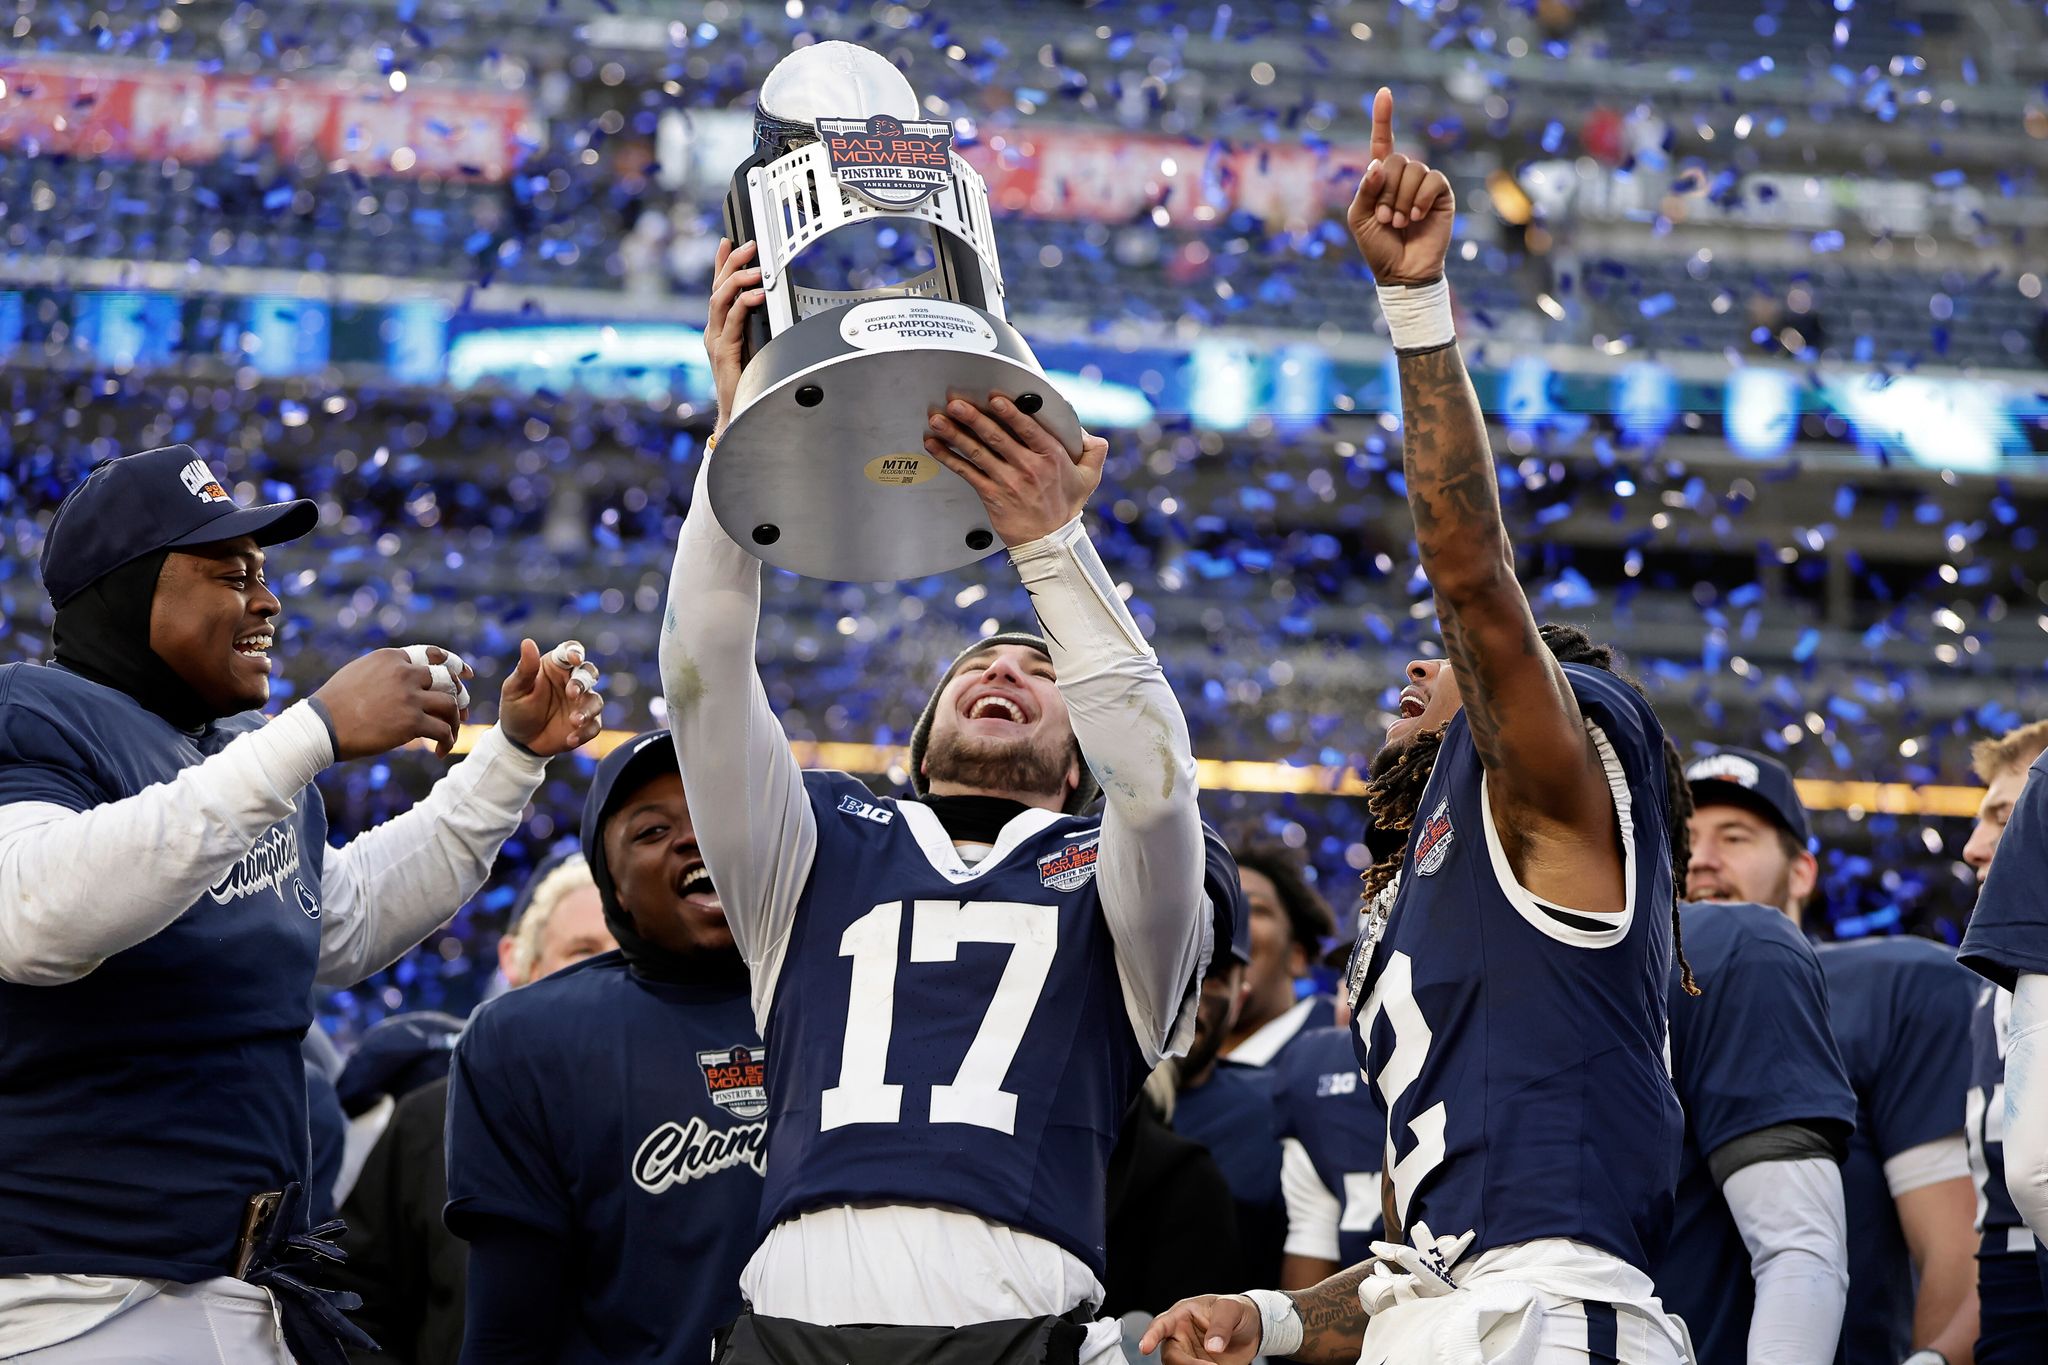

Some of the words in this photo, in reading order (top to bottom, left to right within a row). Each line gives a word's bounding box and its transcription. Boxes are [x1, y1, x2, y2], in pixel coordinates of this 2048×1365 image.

[831, 138, 883, 151] BAD
[891, 140, 942, 153] BOY
[833, 150, 946, 165] MOWERS
[841, 167, 903, 180] PINSTRIPE
[908, 169, 946, 183] BOWL
[864, 314, 897, 323] GEORGE
[867, 320, 977, 334] CHAMPIONSHIP
[897, 329, 954, 339] TROPHY
[882, 459, 919, 470] MTM
[1042, 857, 1069, 871] BAD
[1072, 846, 1097, 860] BOY
[1042, 852, 1097, 877] MOWERS
[1045, 870, 1077, 884] PINSTRIPE
[820, 899, 1059, 1136] 17
[707, 1066, 740, 1079] BAD
[745, 1064, 764, 1075] BO
[715, 1089, 752, 1102] PINSTRIPE
